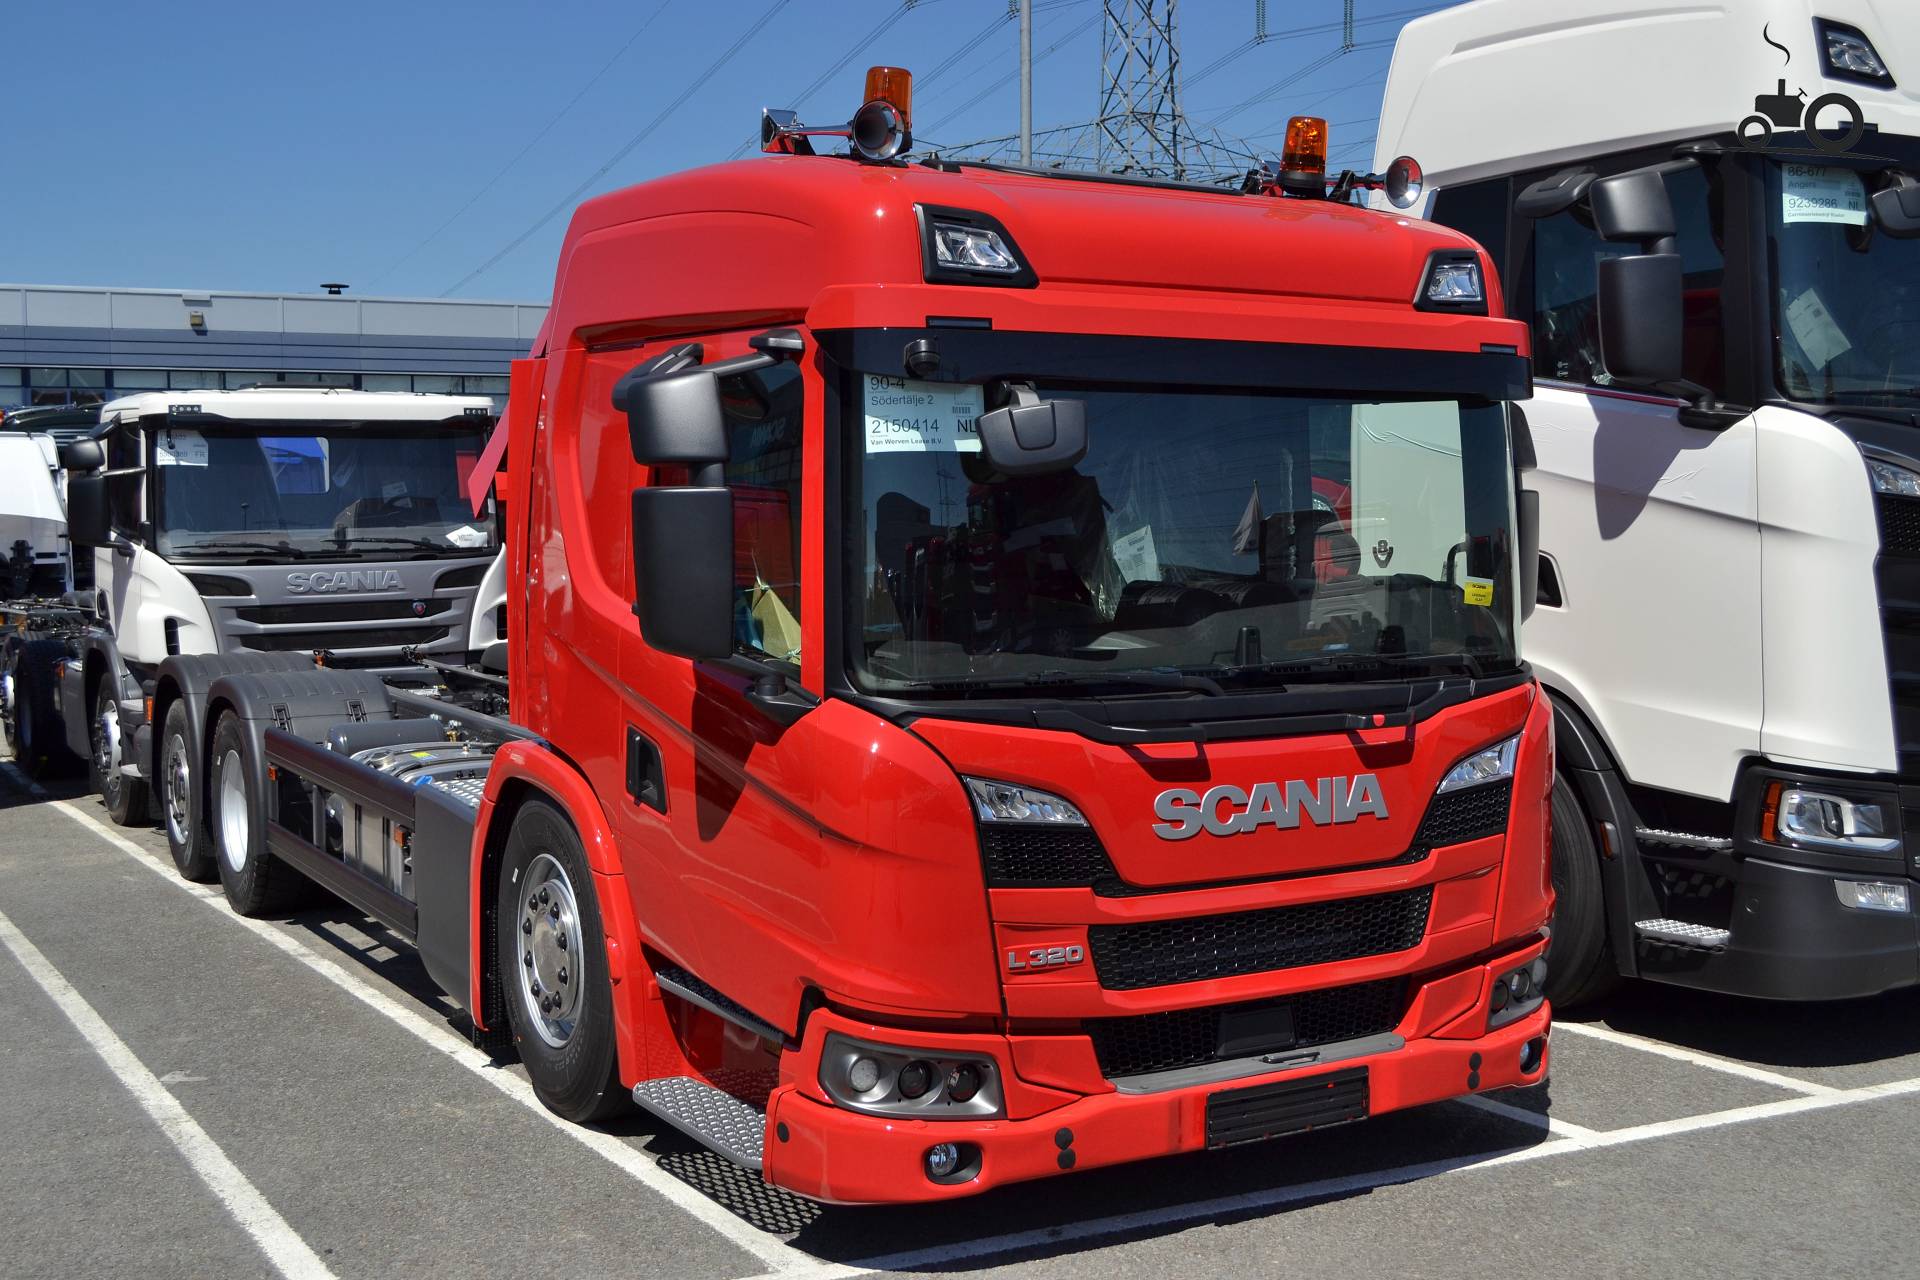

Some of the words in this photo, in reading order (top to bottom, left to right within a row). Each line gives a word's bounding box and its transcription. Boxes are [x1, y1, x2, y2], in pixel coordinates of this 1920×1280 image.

[1788, 197, 1838, 209] 9239286
[871, 395, 925, 407] Södertälje
[927, 395, 934, 405] 2
[871, 418, 940, 434] 2150414
[957, 419, 977, 433] NL
[286, 569, 407, 594] SCANIA
[1151, 773, 1389, 841] SCANIA
[1008, 951, 1026, 969] L
[1029, 945, 1084, 966] 320
